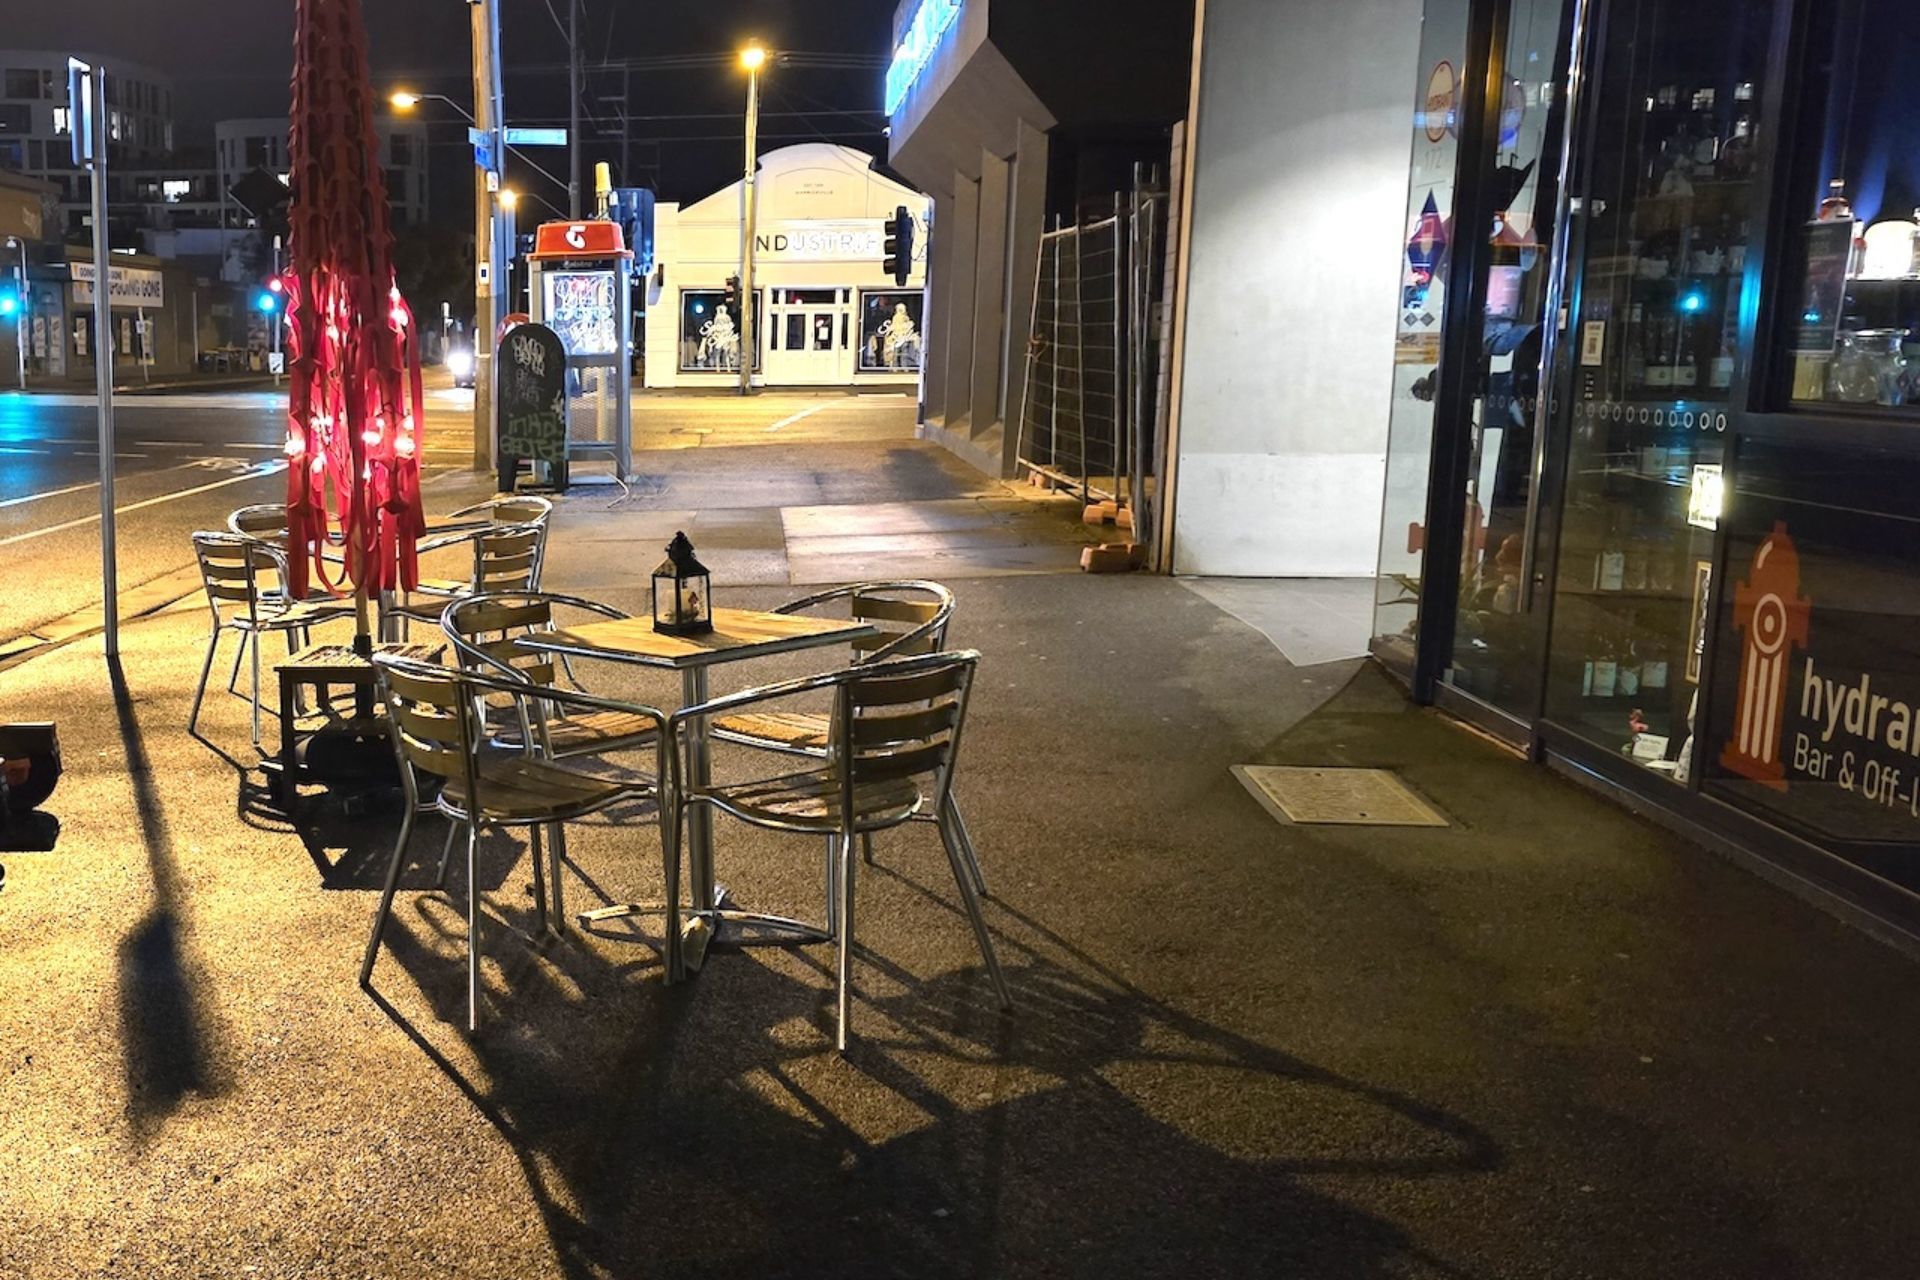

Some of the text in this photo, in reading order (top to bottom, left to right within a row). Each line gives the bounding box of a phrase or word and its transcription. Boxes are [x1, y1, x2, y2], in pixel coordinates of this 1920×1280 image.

[755, 232, 878, 252] NDUSTRIE
[1793, 732, 1833, 781] Bar
[1838, 750, 1855, 792] &
